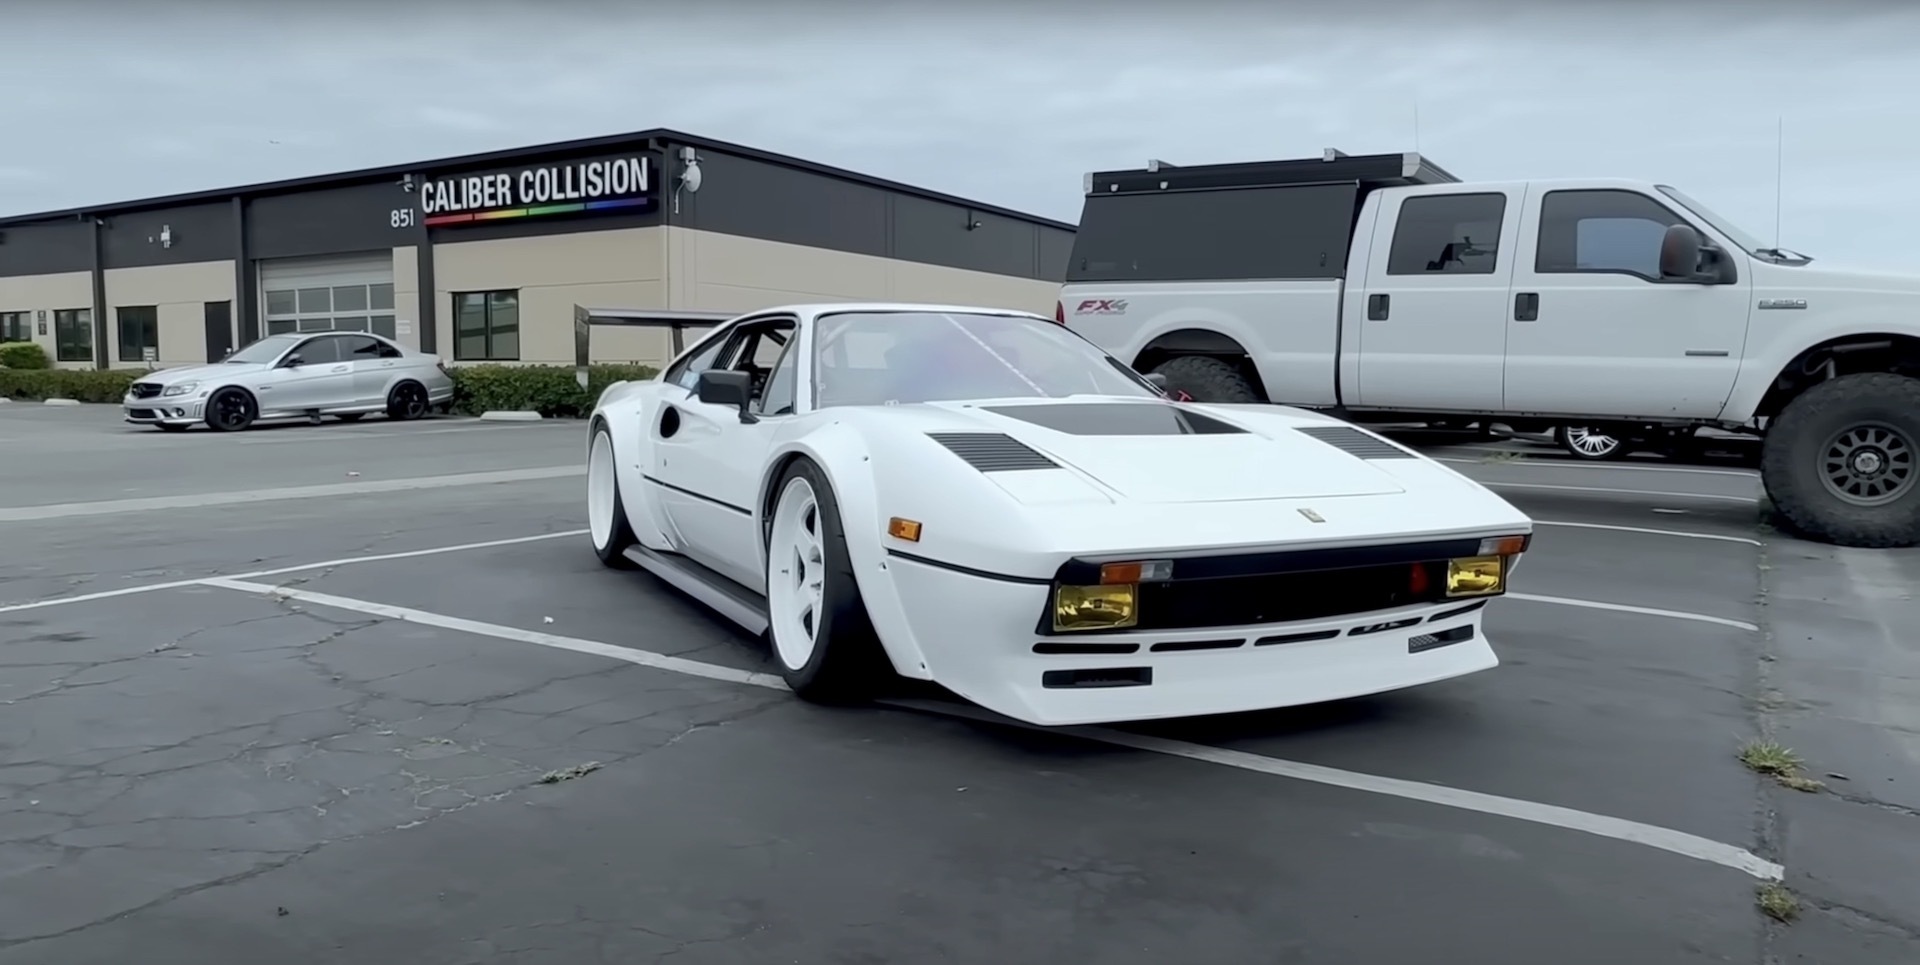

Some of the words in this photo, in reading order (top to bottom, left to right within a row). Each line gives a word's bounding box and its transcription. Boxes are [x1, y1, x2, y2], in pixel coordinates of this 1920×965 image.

[421, 173, 511, 213] CALIBER
[519, 157, 648, 203] COLLISION
[391, 208, 414, 228] 851
[1077, 299, 1129, 311] FX4
